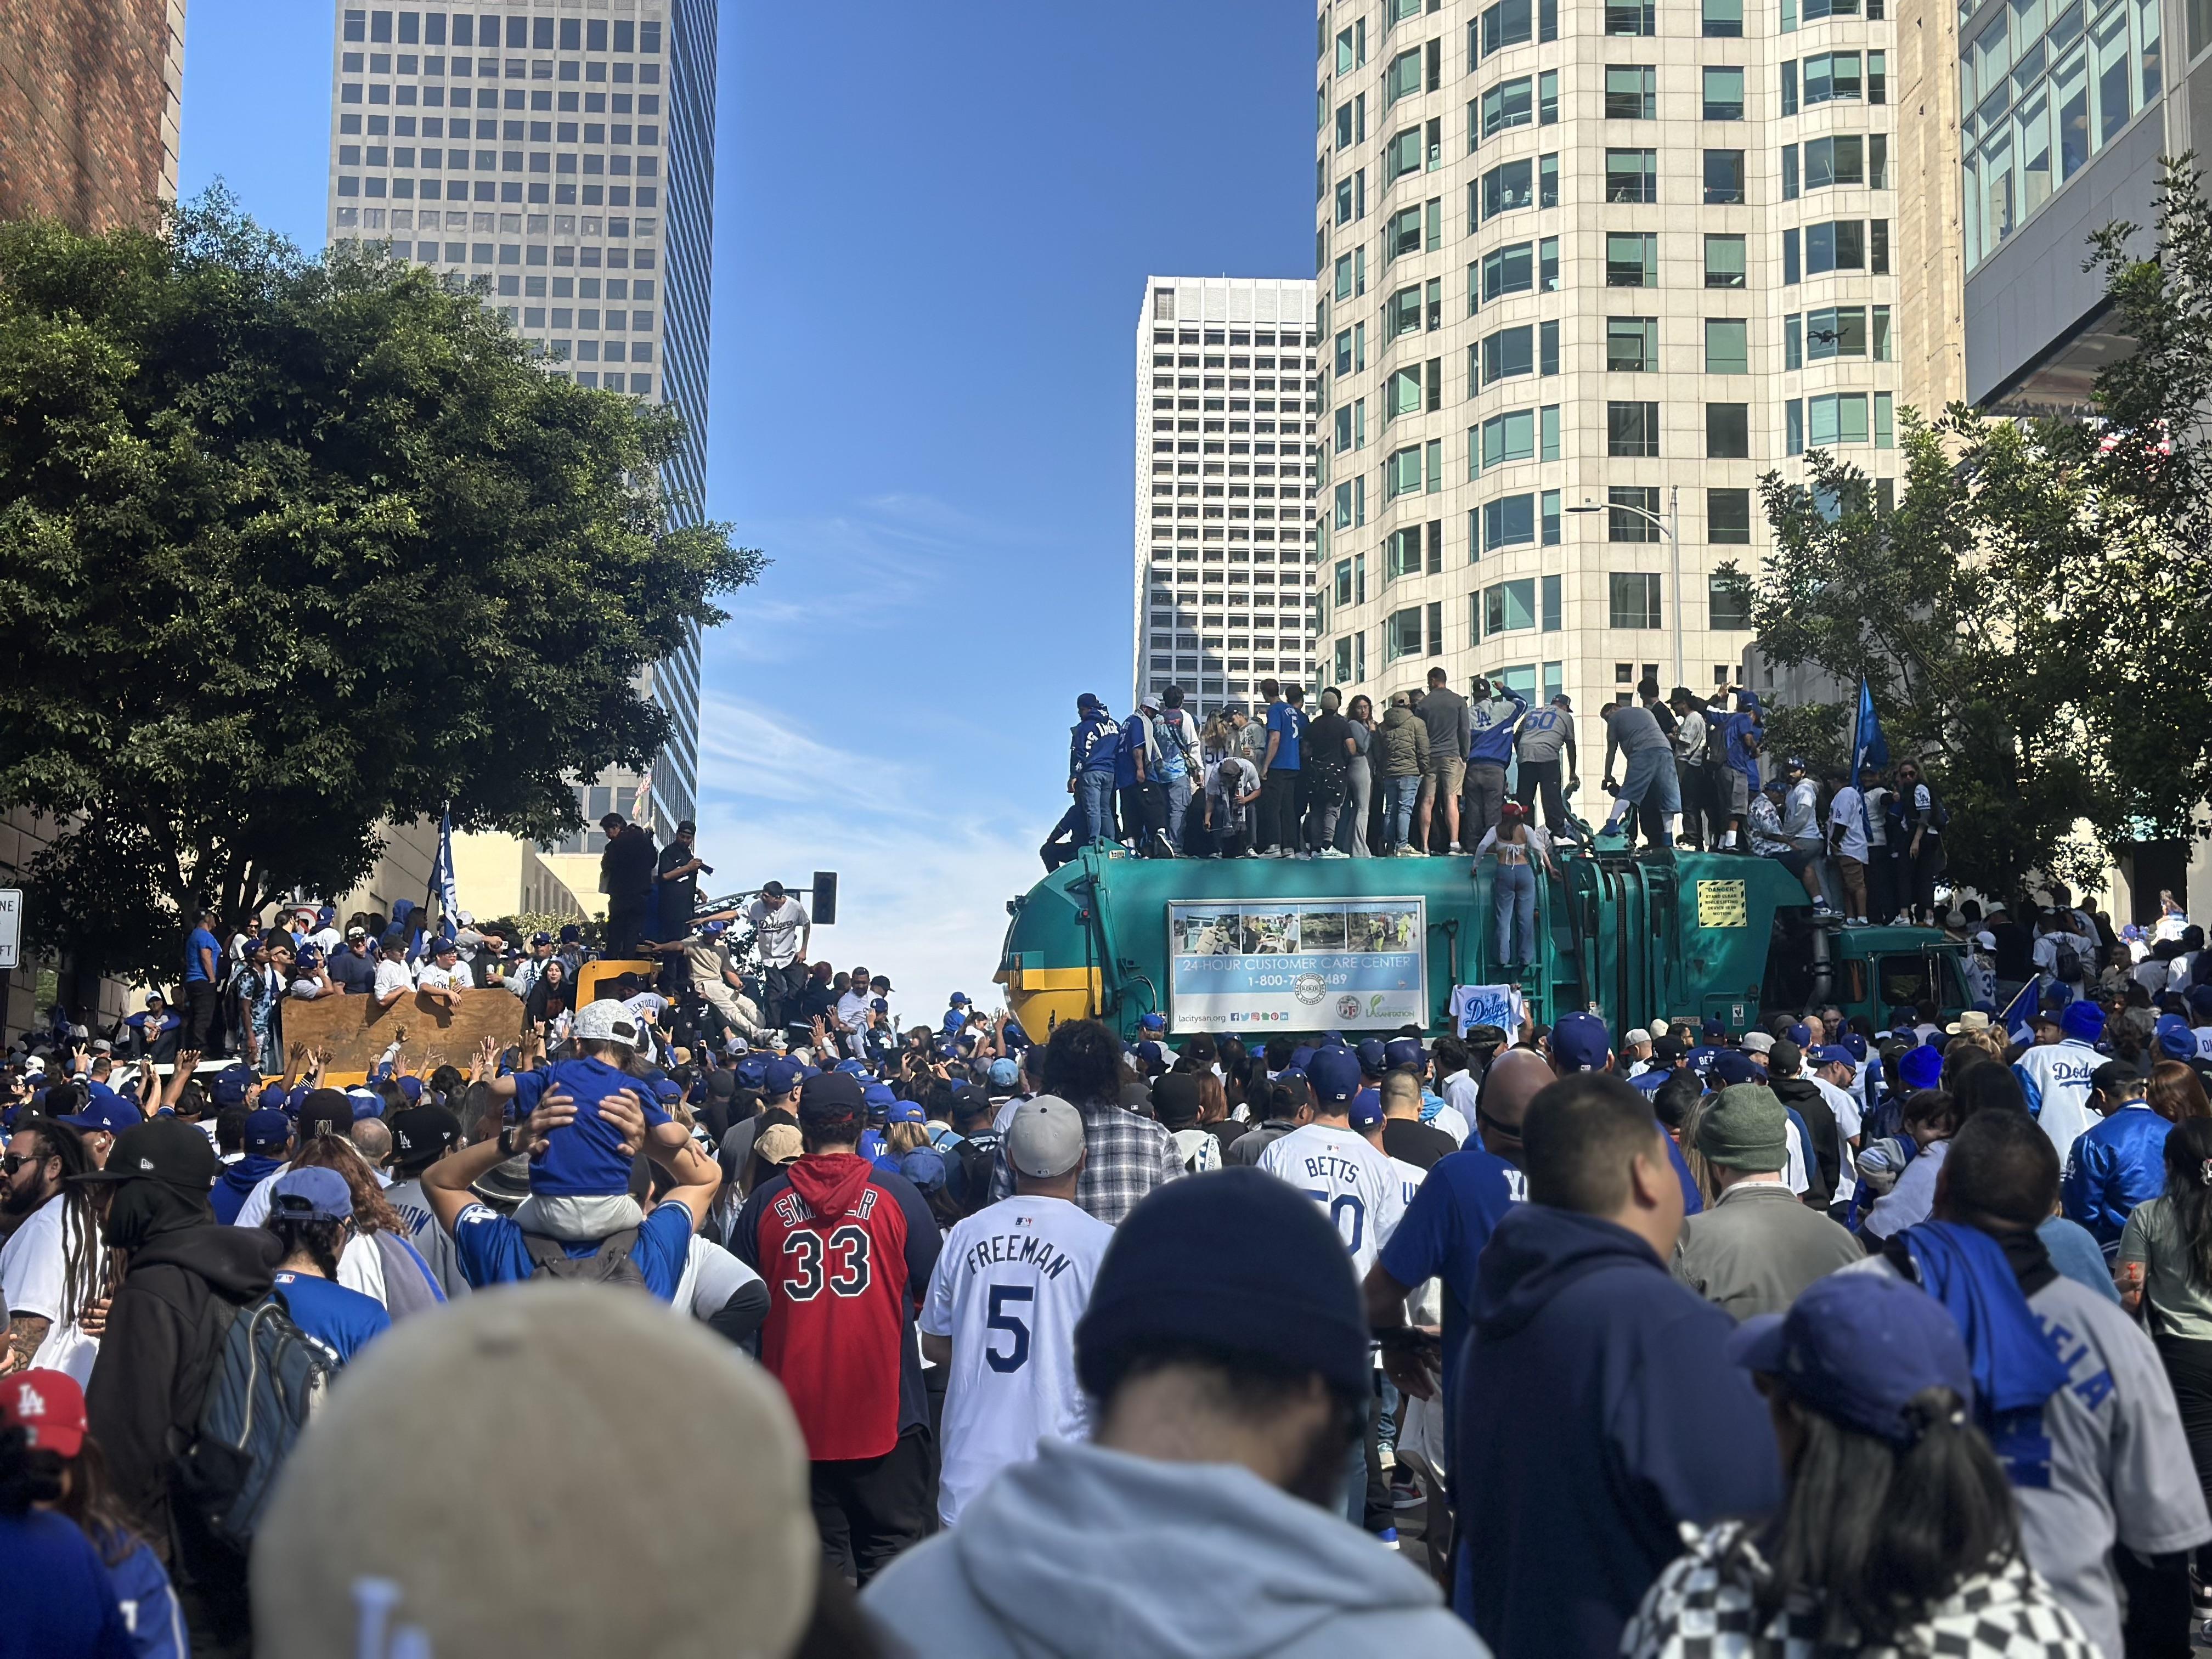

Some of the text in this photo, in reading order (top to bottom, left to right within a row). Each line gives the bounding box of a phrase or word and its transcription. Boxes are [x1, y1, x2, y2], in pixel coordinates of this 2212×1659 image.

[1476, 708, 1492, 727] LA
[1525, 711, 1557, 730] 50
[1291, 716, 1299, 738] 5
[1920, 792, 1929, 804] LA
[0, 900, 14, 912] NE
[759, 919, 793, 934] Dodgers
[0, 945, 12, 956] FT
[1183, 956, 1410, 972] 24-HOUR CUSTOMER CARE CENTER
[1179, 1014, 1226, 1023] lacitysan.org
[1699, 1056, 1714, 1065] BET
[398, 1131, 411, 1149] LA
[1305, 1156, 1359, 1183] BETTS
[783, 1224, 871, 1301] 33
[967, 1234, 1071, 1280] FREEMAN
[985, 1284, 1034, 1374] 5
[18, 1383, 46, 1417] LA
